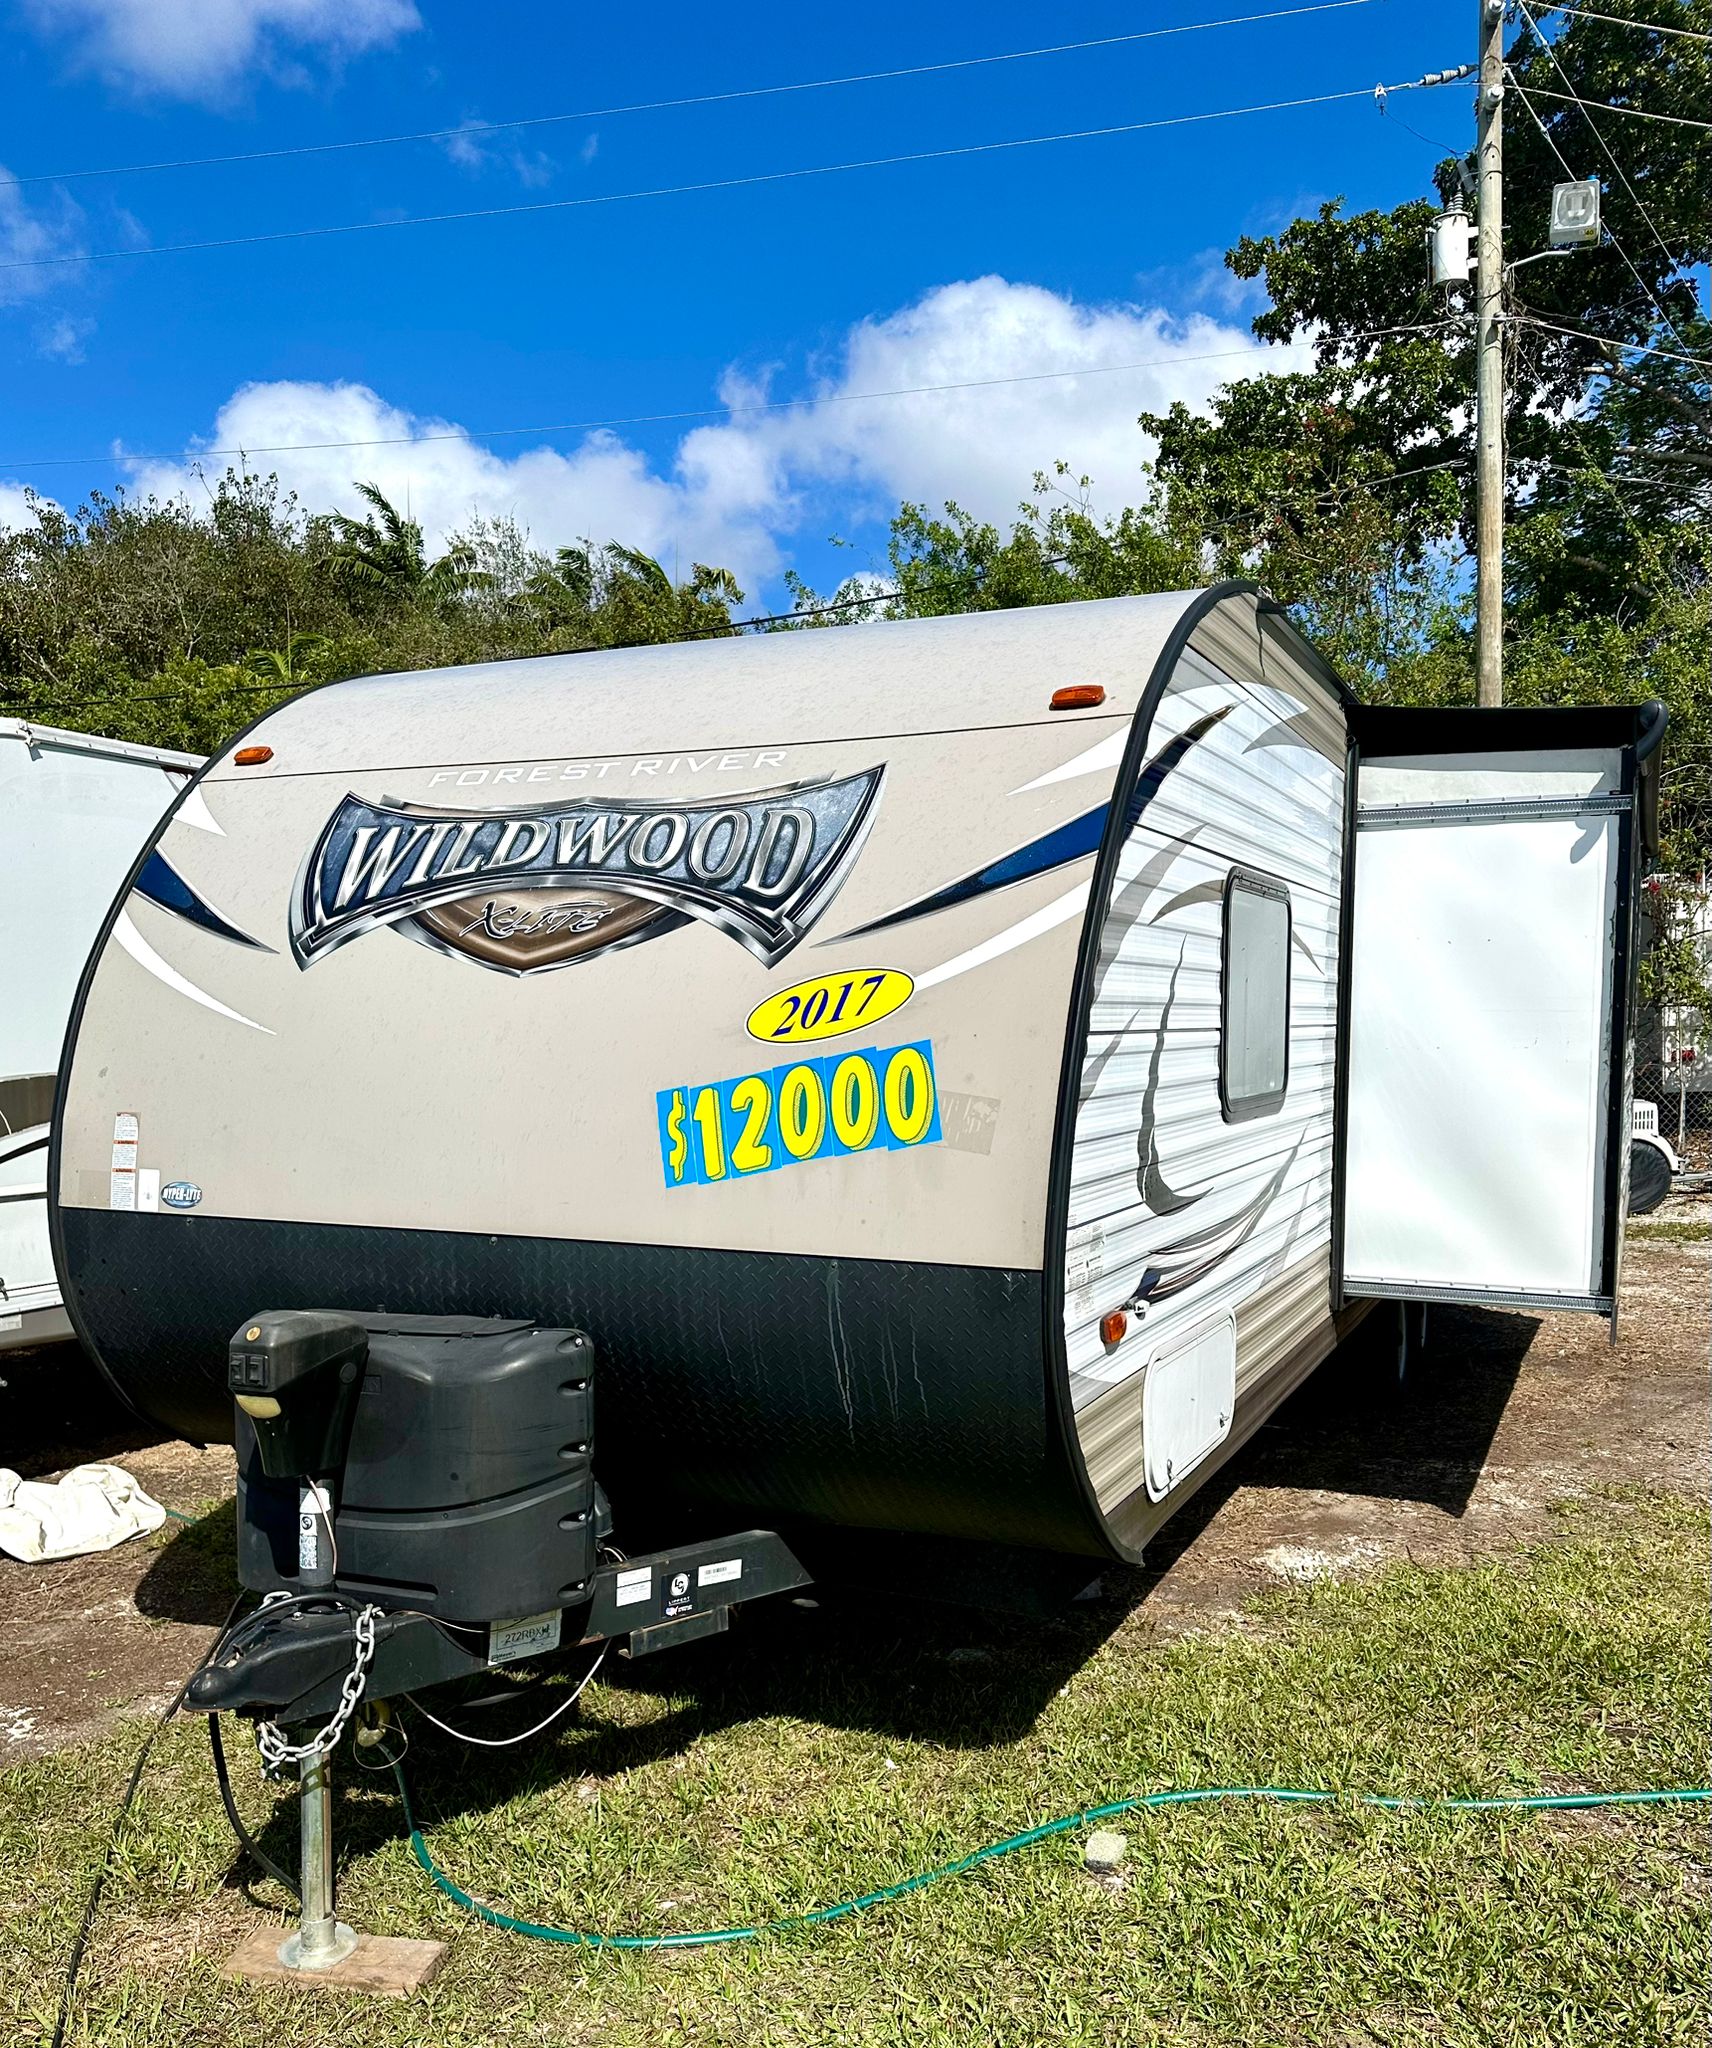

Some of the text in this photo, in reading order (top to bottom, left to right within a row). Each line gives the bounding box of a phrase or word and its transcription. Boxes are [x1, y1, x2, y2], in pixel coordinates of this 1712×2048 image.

[427, 750, 788, 788] FOREST RIVER
[334, 805, 818, 908] WILDWOOD
[771, 973, 887, 1037] 2017
[665, 1047, 934, 1183] $12000
